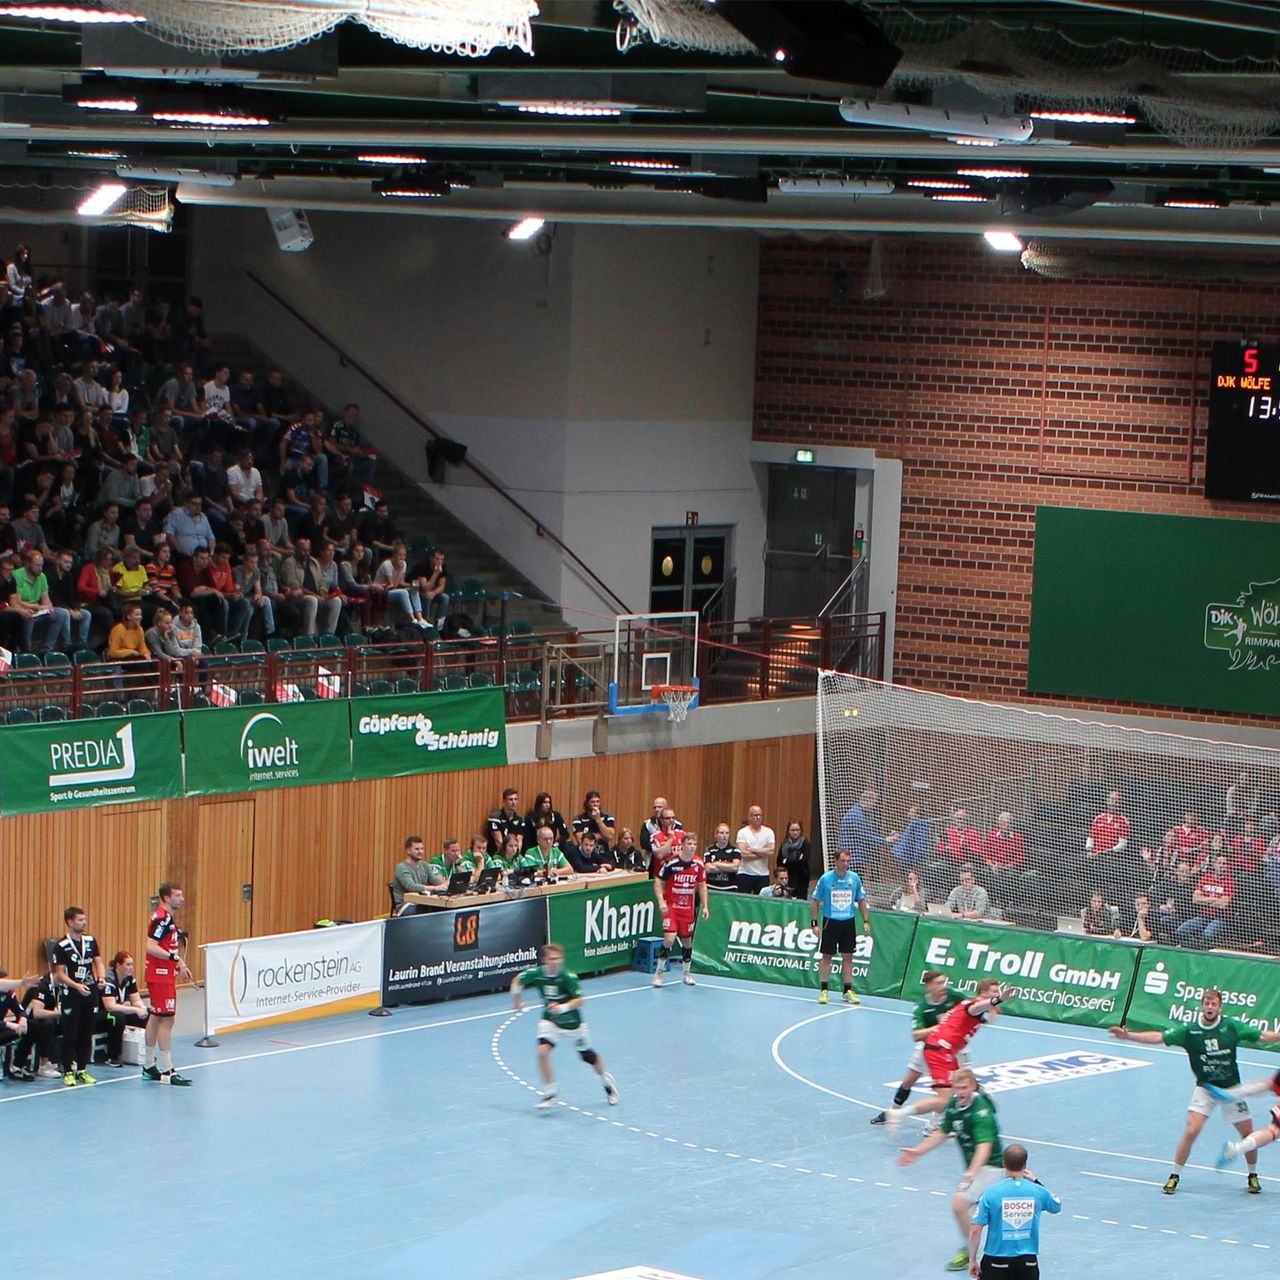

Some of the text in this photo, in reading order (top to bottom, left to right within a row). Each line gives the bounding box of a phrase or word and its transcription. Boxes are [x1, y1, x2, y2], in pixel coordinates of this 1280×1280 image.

[1243, 348, 1259, 374] 5
[1217, 375, 1271, 390] DJK WÖLFE
[1245, 637, 1280, 649] RIMPAR
[358, 713, 423, 737] Göpfert
[426, 728, 500, 752] Schömig
[247, 735, 299, 770] iwelt
[50, 791, 67, 803] Sport
[584, 894, 655, 945] Kham
[256, 949, 350, 989] rockenstein
[388, 964, 419, 982] Laurin
[420, 960, 446, 979] Brand
[446, 945, 538, 975] Veranstaltungstechnik
[724, 951, 810, 971] INTERNATIONALE
[925, 937, 956, 967] E.
[966, 942, 1045, 984] Troll
[1049, 963, 1121, 991] GmbH
[255, 981, 362, 1009] Internet-Service-Provider
[1004, 1202, 1033, 1211] BOSCH
